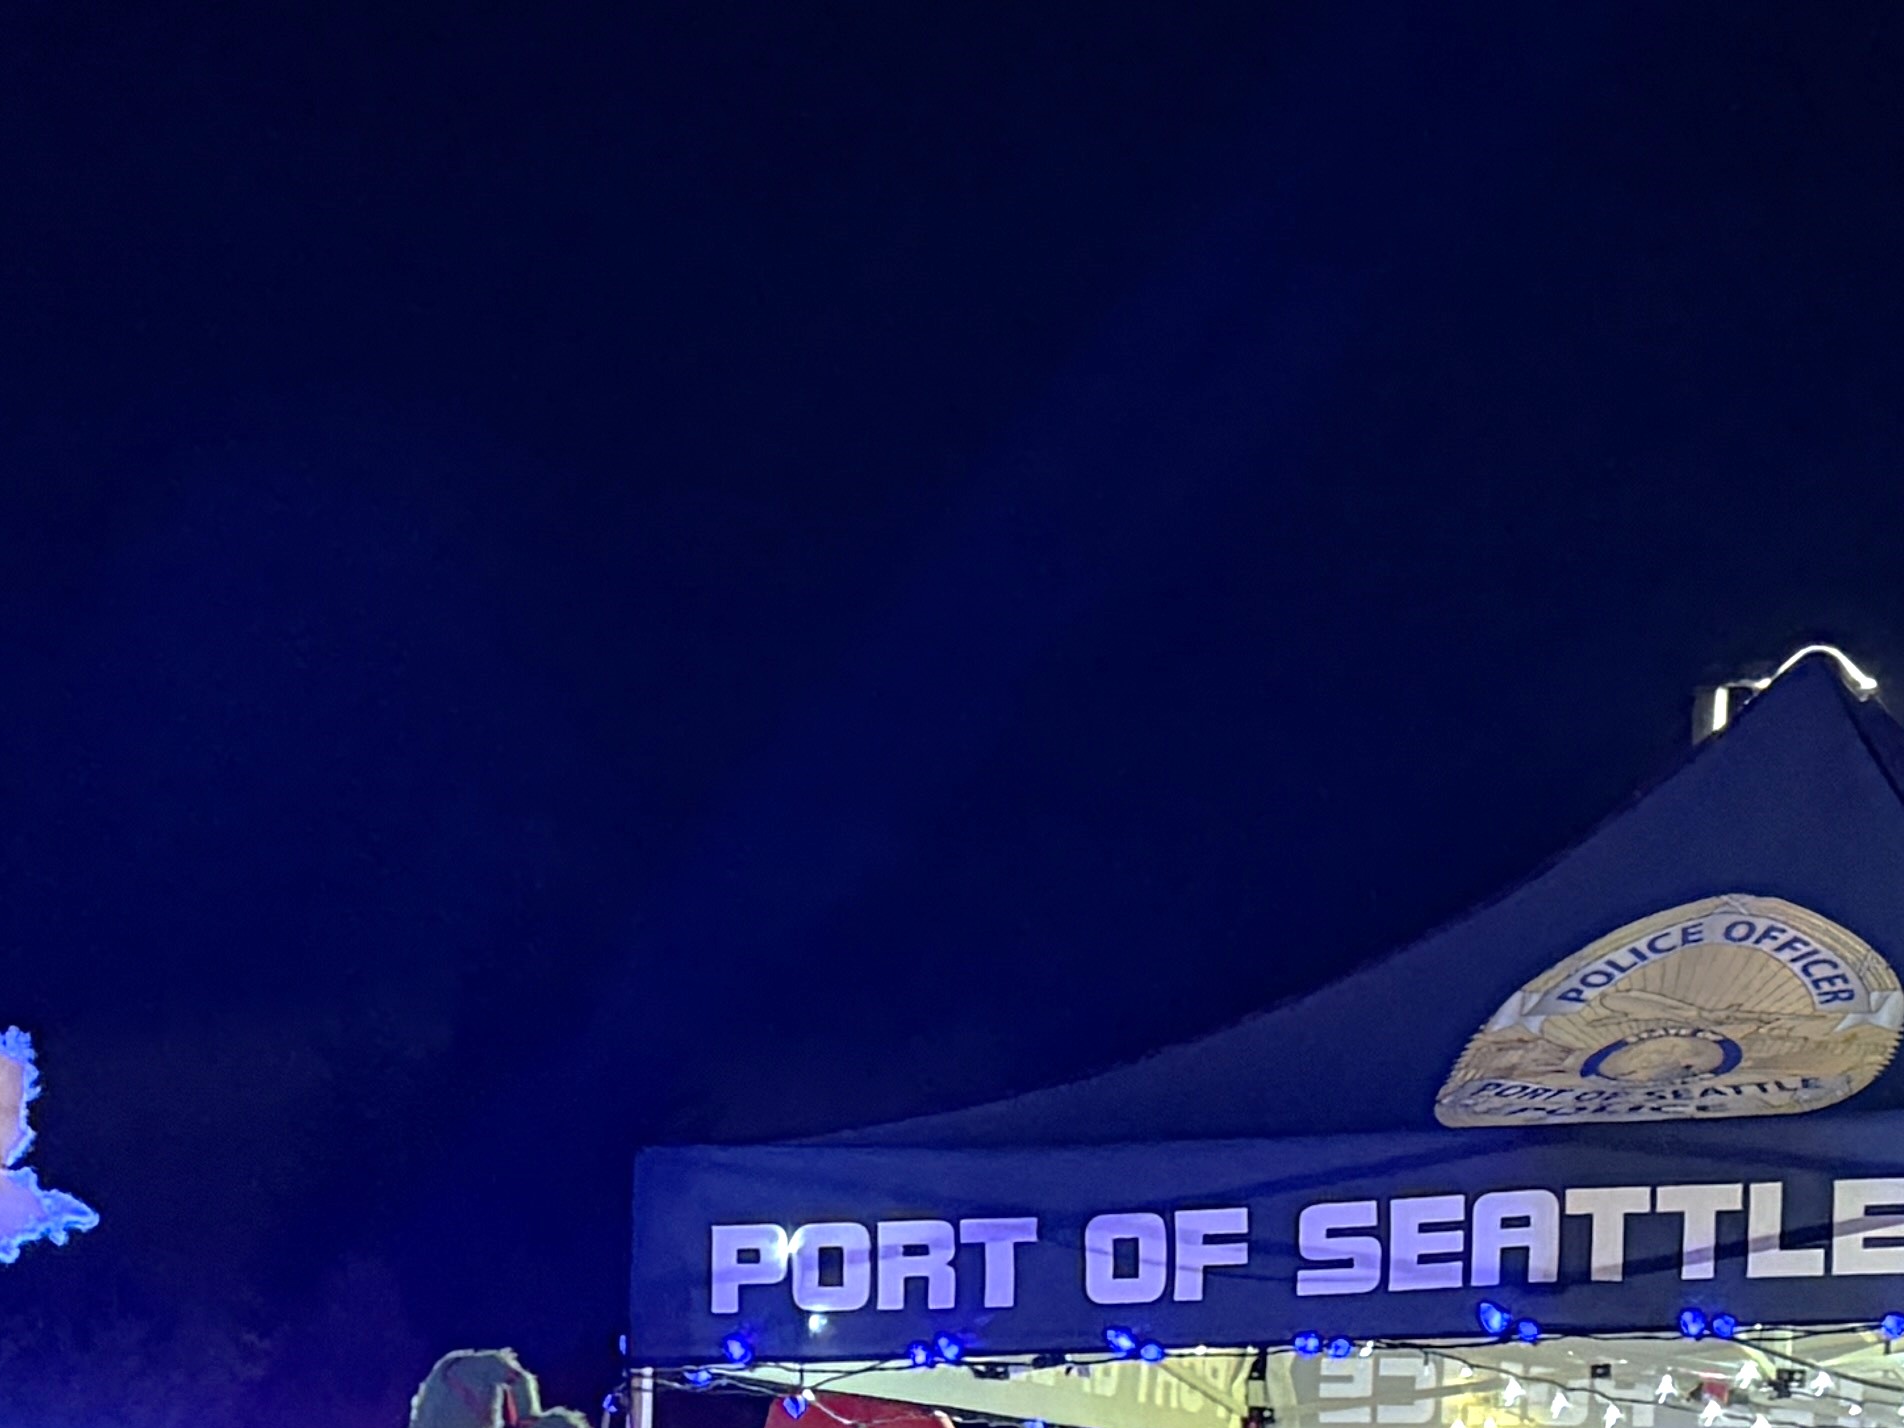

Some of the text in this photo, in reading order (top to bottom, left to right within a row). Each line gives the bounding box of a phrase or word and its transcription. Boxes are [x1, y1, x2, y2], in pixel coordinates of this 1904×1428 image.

[1557, 920, 1856, 1005] POLICE OFFICER
[1470, 1080, 1569, 1101] PORT
[1645, 1077, 1823, 1100] SEATTLE
[710, 1216, 1039, 1315] PORT
[1083, 1206, 1250, 1305] OF
